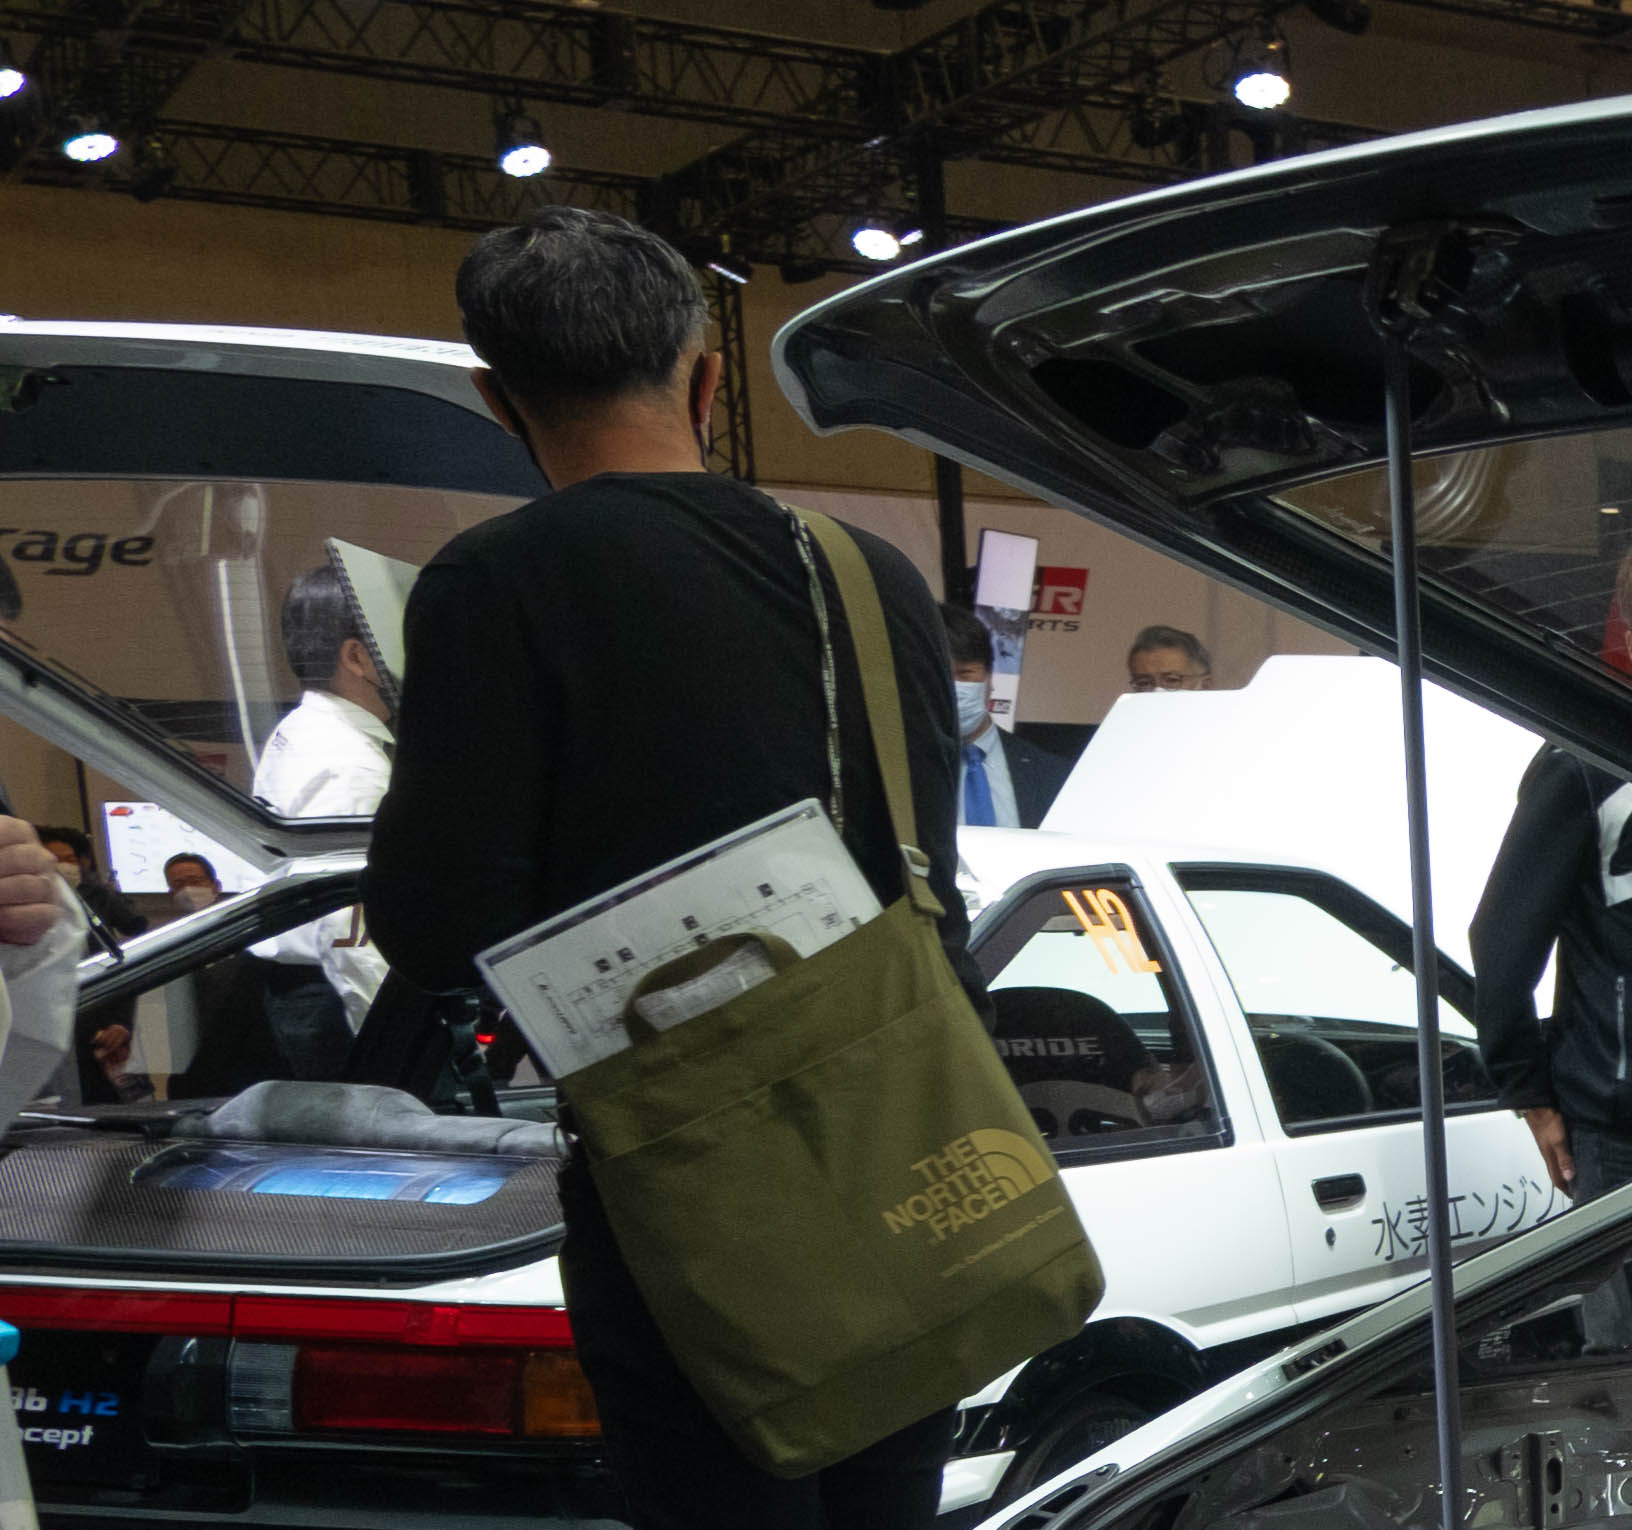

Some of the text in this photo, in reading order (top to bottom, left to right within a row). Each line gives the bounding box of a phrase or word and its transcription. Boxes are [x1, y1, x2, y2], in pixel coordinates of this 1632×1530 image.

[0, 528, 155, 576] age
[1061, 888, 1163, 975] H2
[911, 1136, 979, 1183] THE
[881, 1156, 995, 1235] NORTH
[928, 1182, 1009, 1241] FACE
[58, 1391, 120, 1416] H2
[20, 1425, 94, 1450] cept
